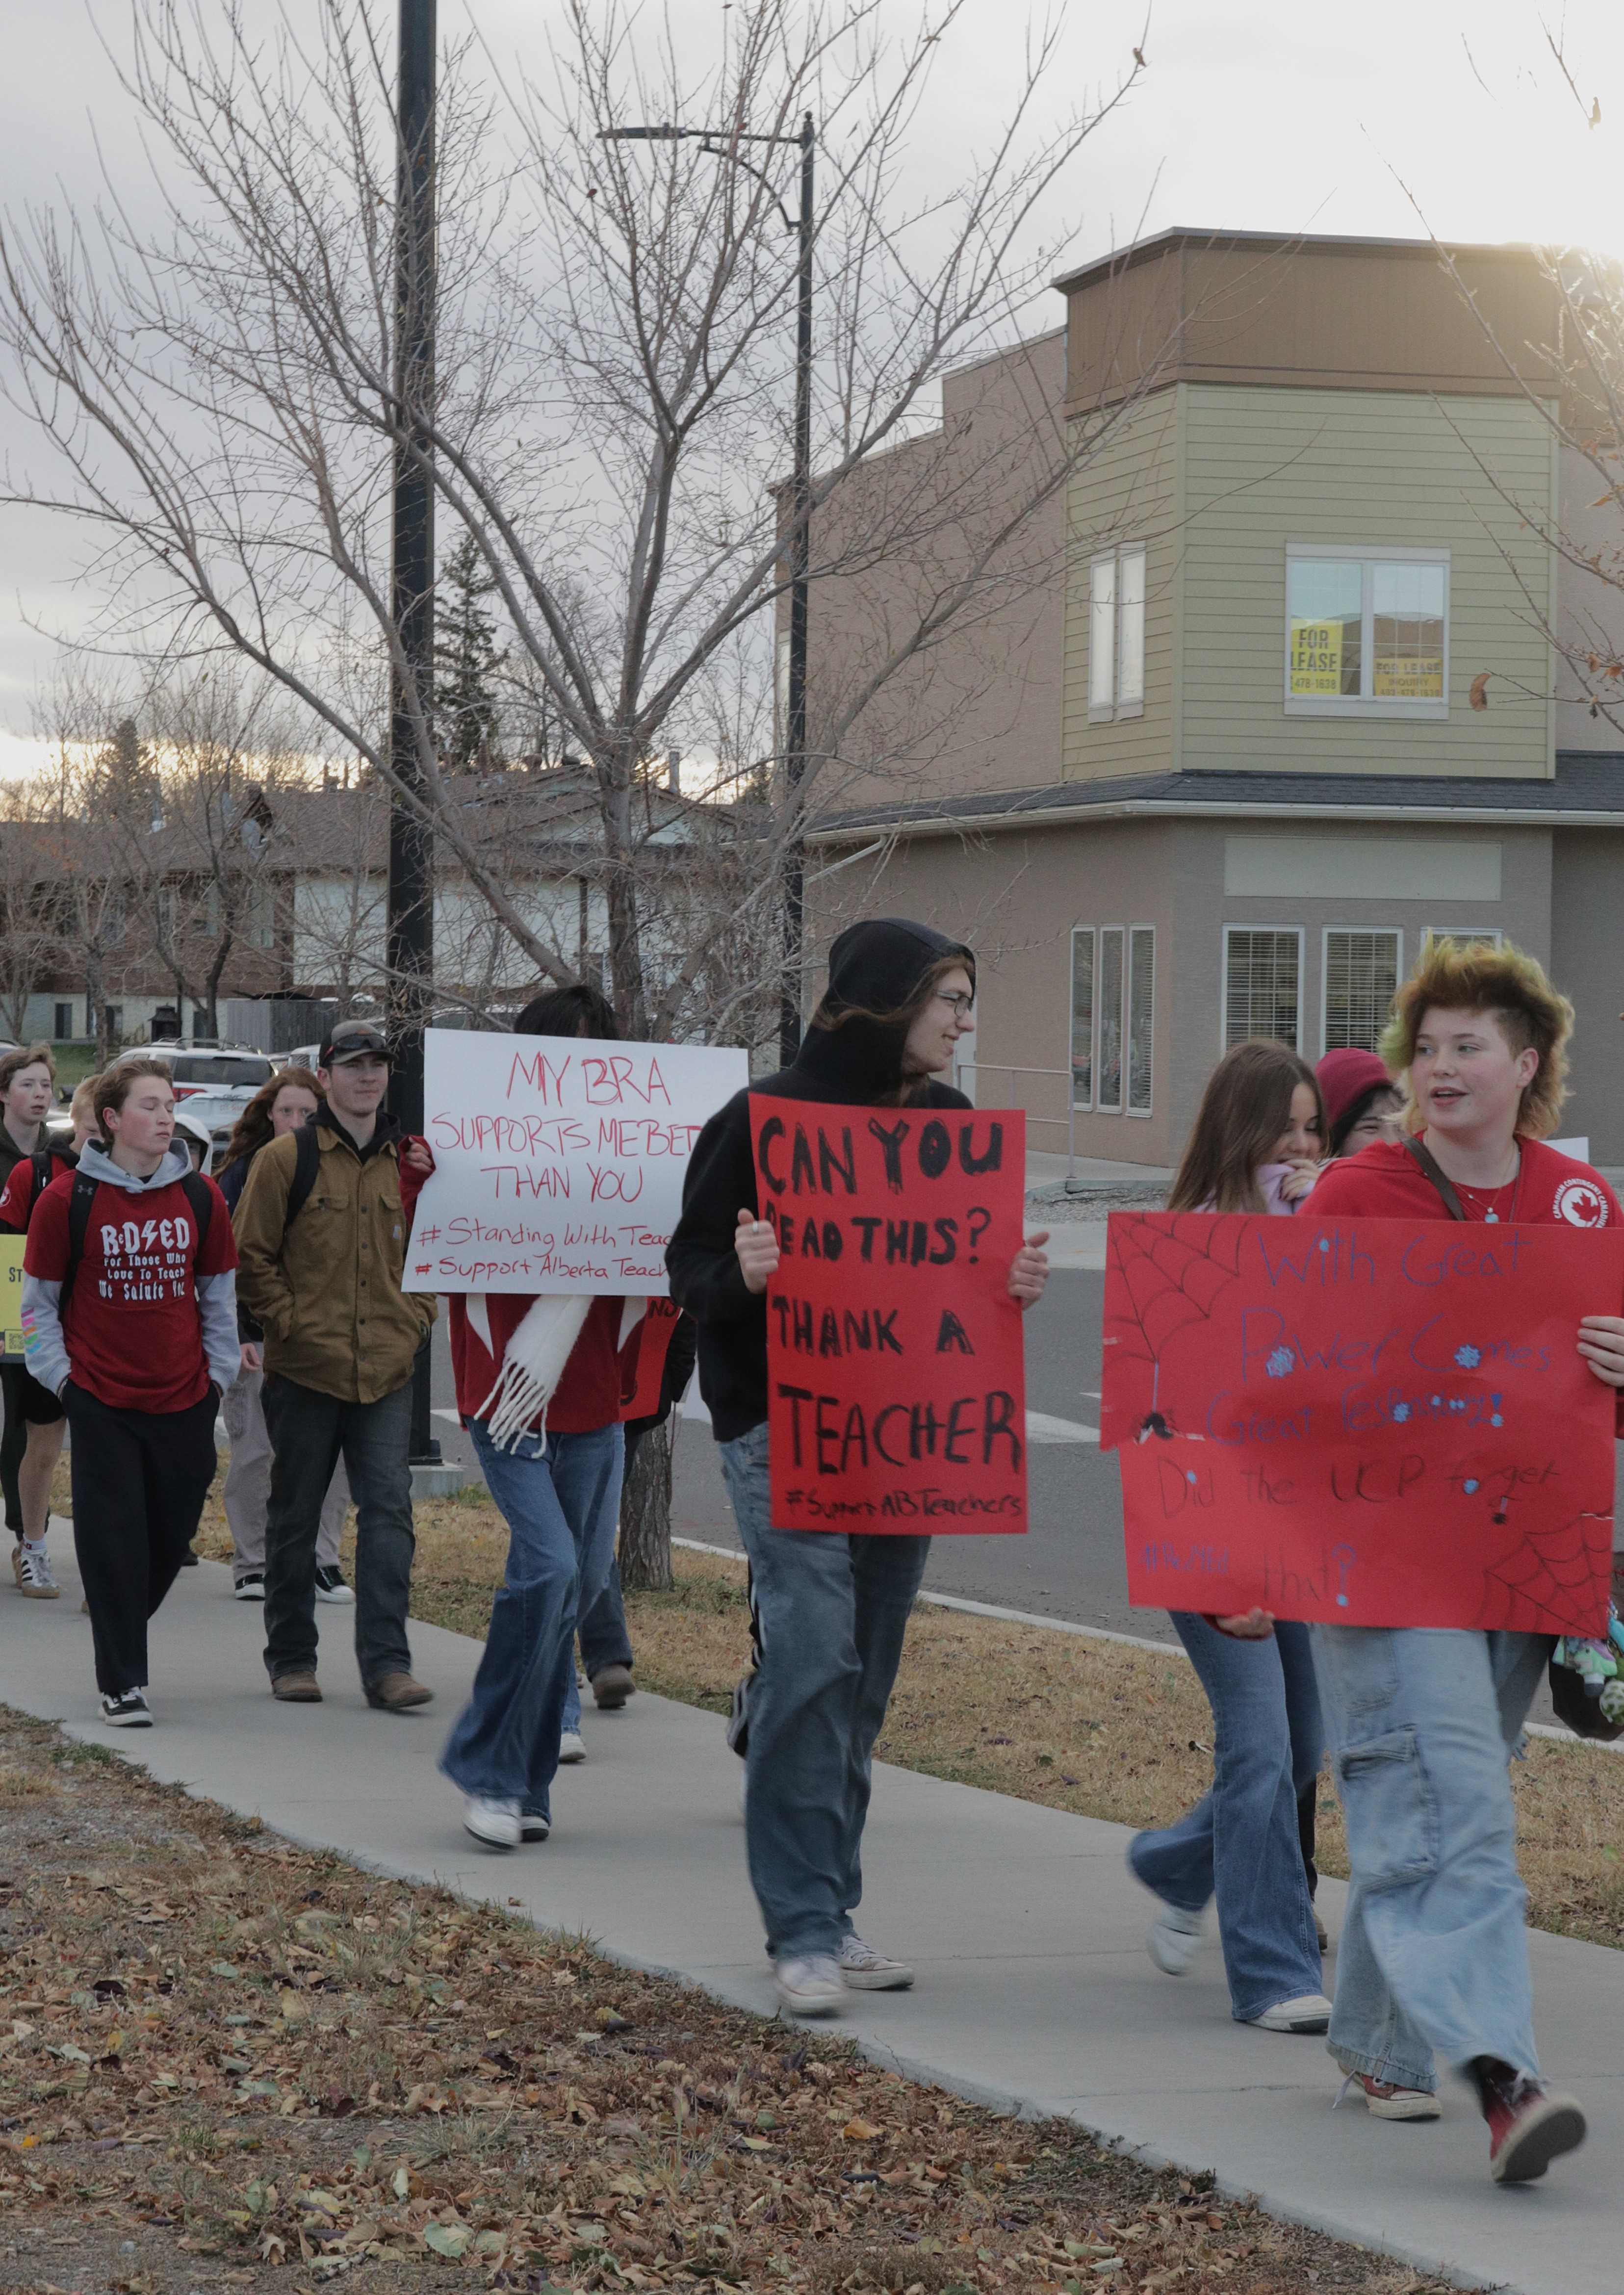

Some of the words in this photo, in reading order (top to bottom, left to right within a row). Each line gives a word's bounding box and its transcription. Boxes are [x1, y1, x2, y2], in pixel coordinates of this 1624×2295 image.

[1290, 651, 1337, 672] LEASE
[1298, 628, 1329, 649] FOR
[1376, 662, 1398, 675] FOR
[1403, 662, 1441, 675] LEASE
[507, 1051, 571, 1107] MY
[581, 1056, 672, 1106] BRA
[432, 1111, 591, 1157] SUPPORTS
[758, 1116, 857, 1195] CAN
[868, 1116, 1003, 1195] YOU
[480, 1164, 570, 1199] THAN
[587, 1162, 644, 1203] YOU
[1552, 1184, 1568, 1219] CANADIAN
[128, 1254, 160, 1267] Those
[166, 1252, 186, 1264] Who
[851, 1206, 991, 1267] THIS?
[1257, 1227, 1376, 1288] With
[1401, 1230, 1533, 1287] Great
[99, 1279, 113, 1299] We
[124, 1281, 164, 1301] Salute
[107, 1268, 133, 1280] Love
[140, 1268, 152, 1280] To
[157, 1267, 185, 1280] Teach
[540, 1255, 609, 1280] Alberta
[772, 1295, 903, 1357] THANK
[935, 1309, 976, 1356] A
[1241, 1306, 1402, 1383] Power
[1409, 1313, 1552, 1374] Comes
[776, 1383, 1022, 1476] TEACHER
[1207, 1389, 1316, 1446] Great
[1157, 1455, 1215, 1521] Did
[1331, 1453, 1425, 1503] UCP
